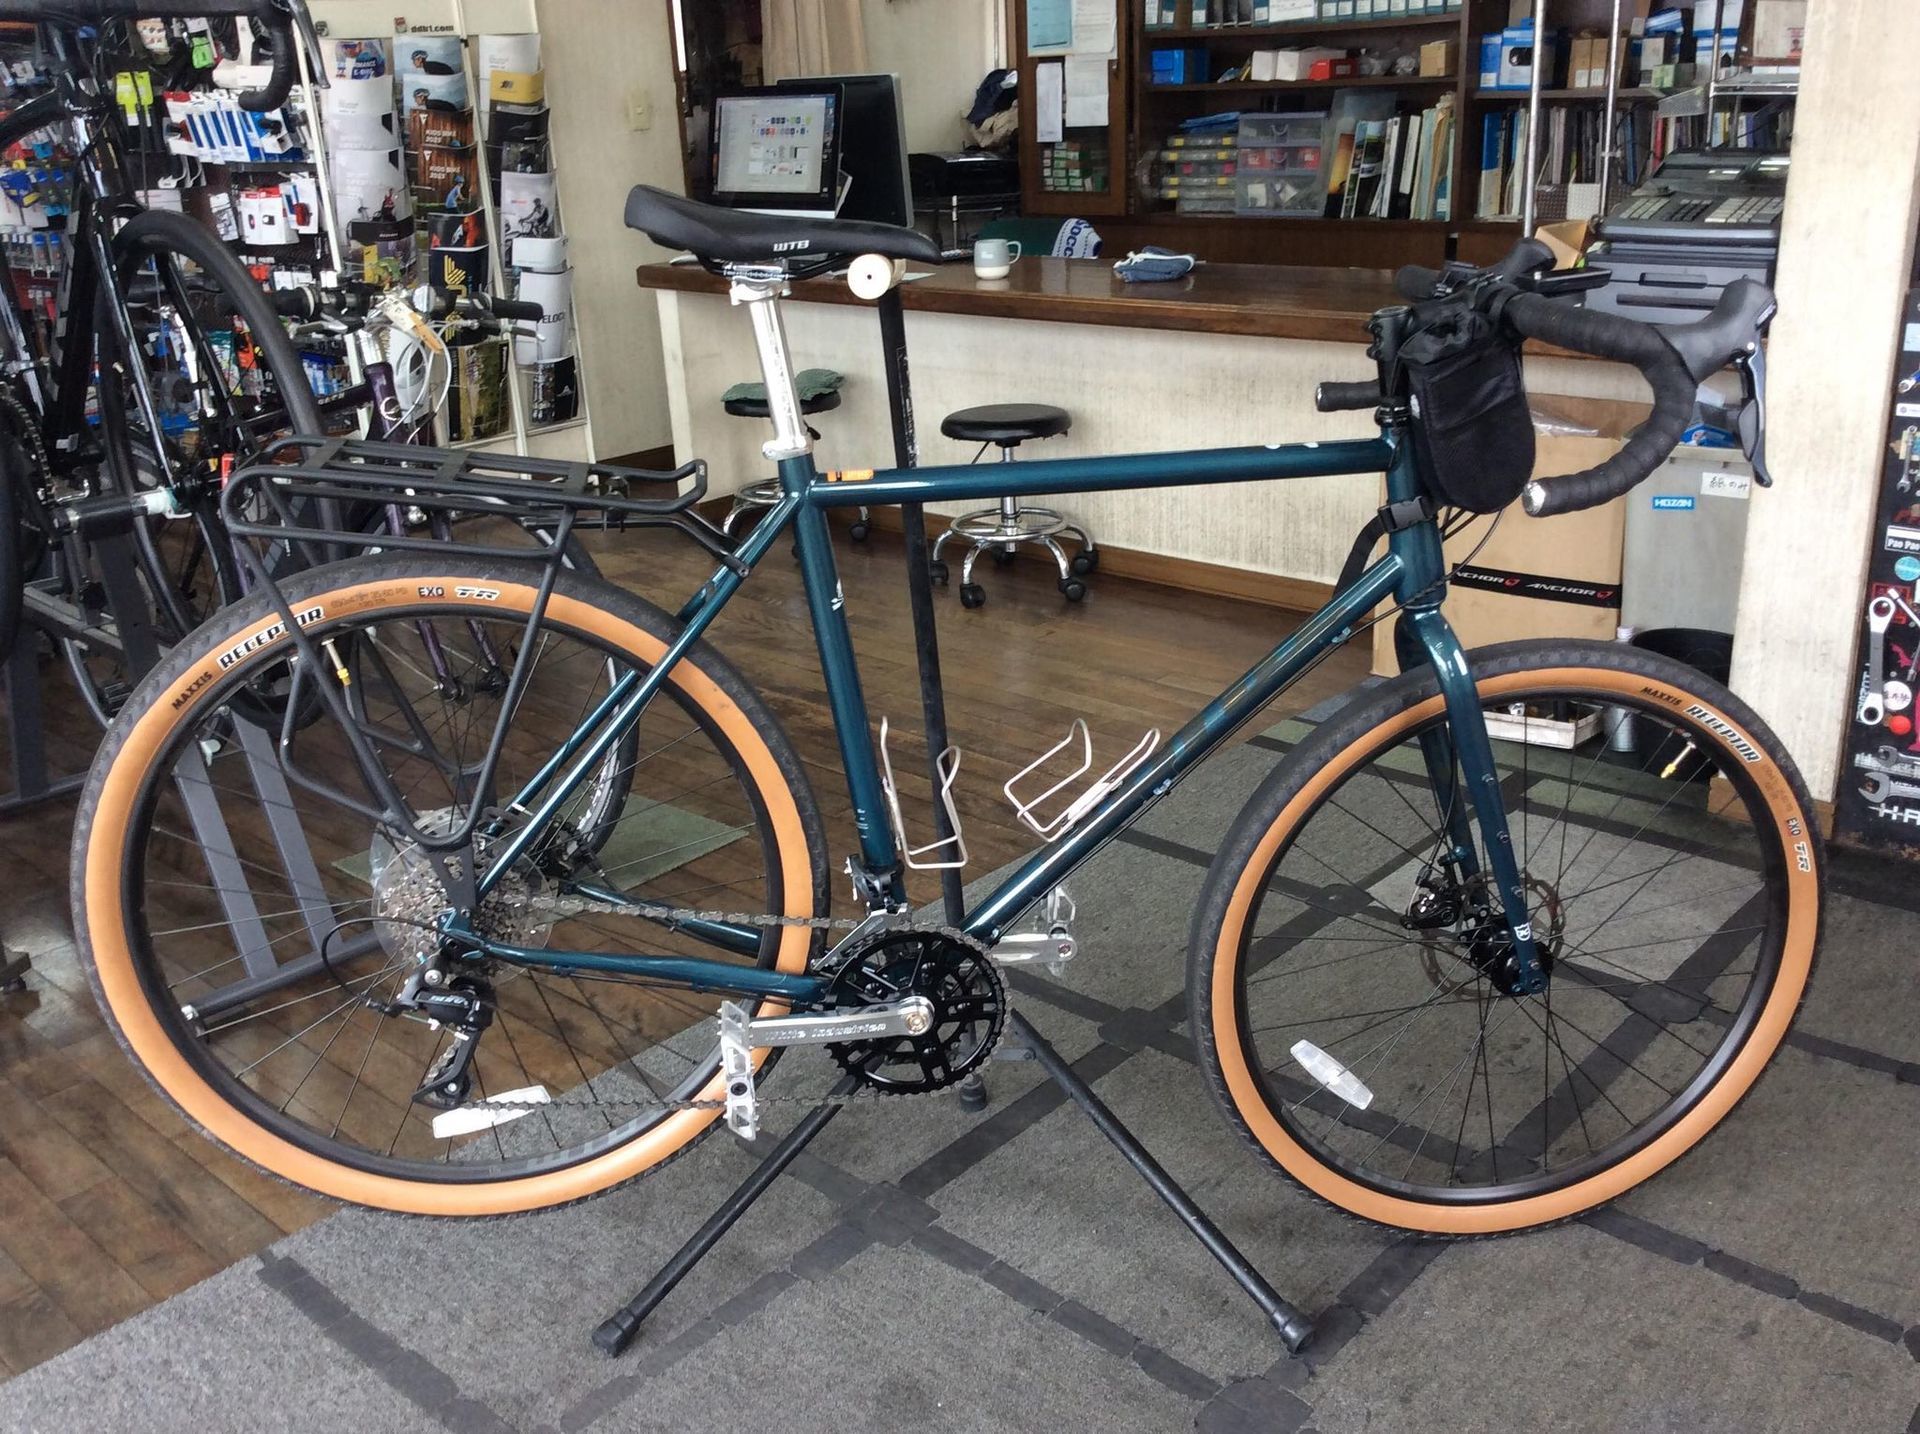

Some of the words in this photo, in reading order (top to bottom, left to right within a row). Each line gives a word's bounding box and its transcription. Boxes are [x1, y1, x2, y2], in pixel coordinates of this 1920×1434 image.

[773, 240, 810, 251] WTB
[1456, 571, 1505, 584] NCHOR
[1526, 583, 1596, 597] ANCHOR
[171, 671, 213, 710] MAXXIS
[418, 586, 445, 598] EXO
[1640, 687, 1682, 706] MAXXIS
[1684, 705, 1761, 762] RECEPTOR
[1786, 817, 1802, 837] EXO
